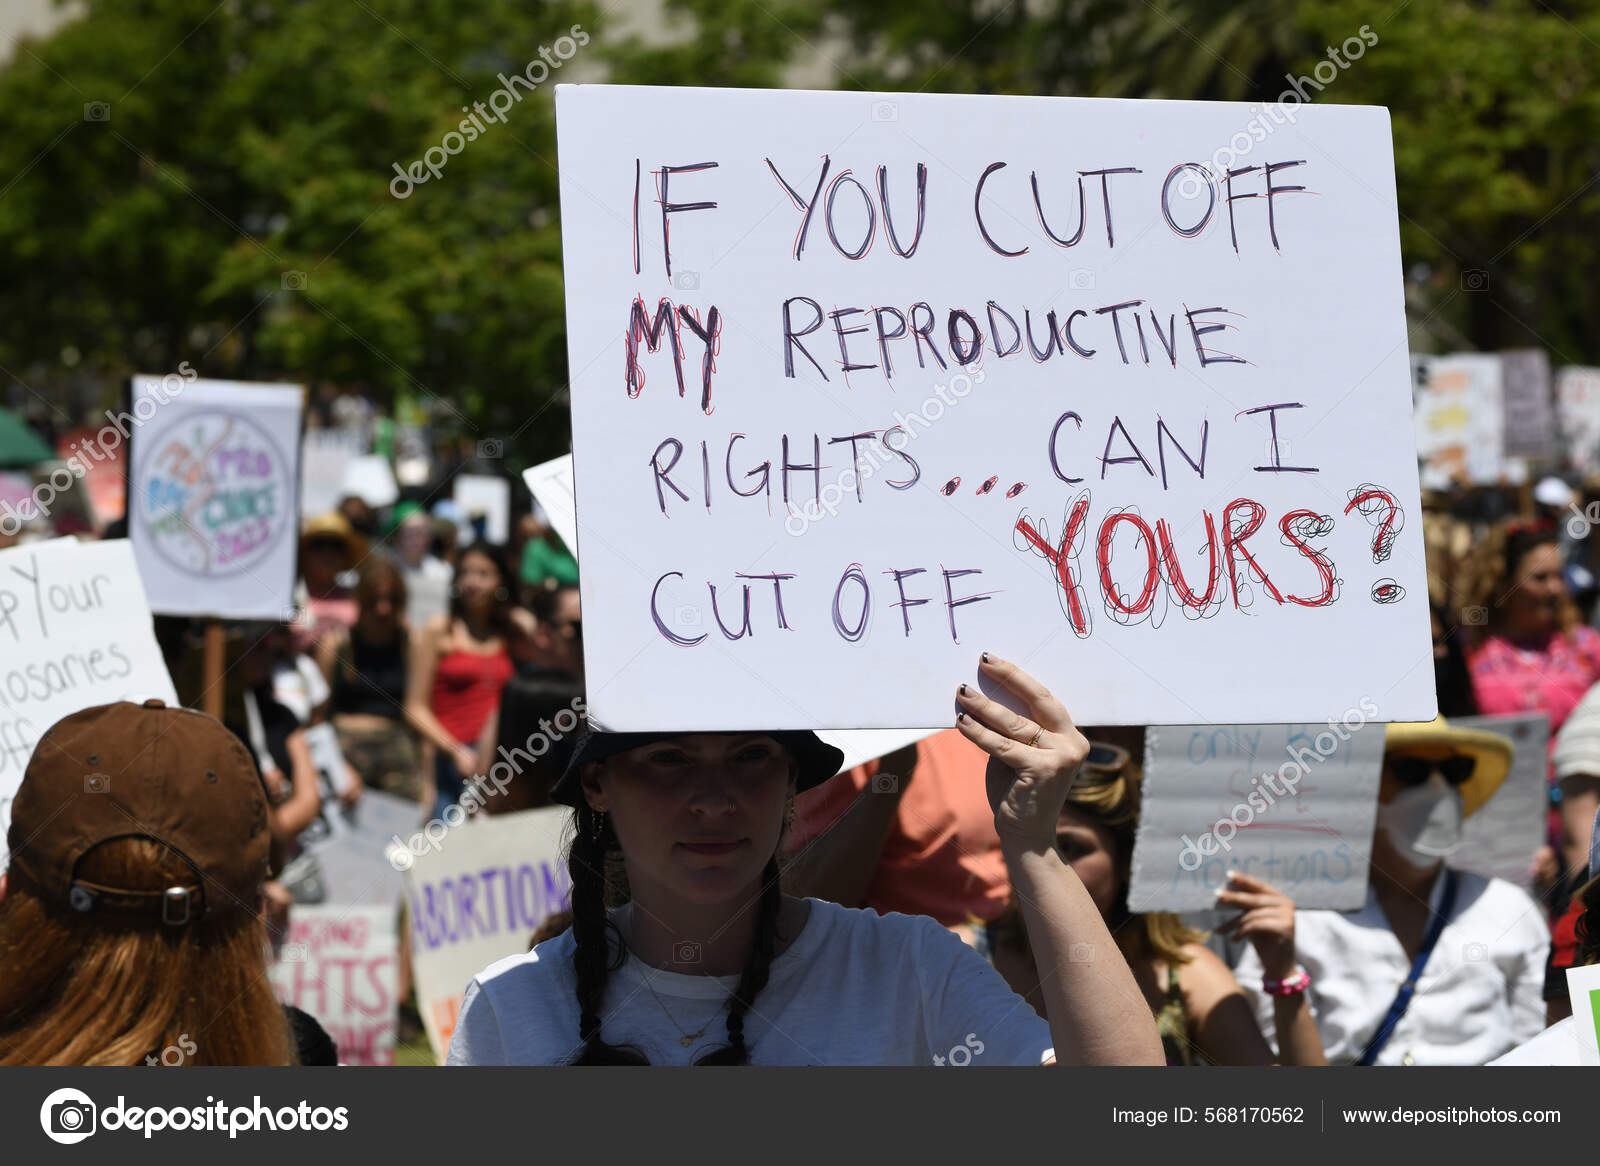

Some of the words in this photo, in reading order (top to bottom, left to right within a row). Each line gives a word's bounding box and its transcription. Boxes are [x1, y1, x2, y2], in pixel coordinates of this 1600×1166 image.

[633, 158, 719, 285] IF
[763, 154, 927, 261] YOU
[975, 161, 1143, 257] CUT
[1161, 159, 1320, 262] OFF
[625, 292, 723, 416] MY
[782, 296, 1258, 393] REPRODUCTIVE
[1048, 409, 1208, 491] CAN
[1235, 402, 1320, 474] I
[11, 553, 111, 638] Your
[650, 571, 798, 648] CUT
[831, 562, 1005, 646] OFF
[1013, 484, 1405, 640] YOURS?
[0, 643, 131, 708] osaries
